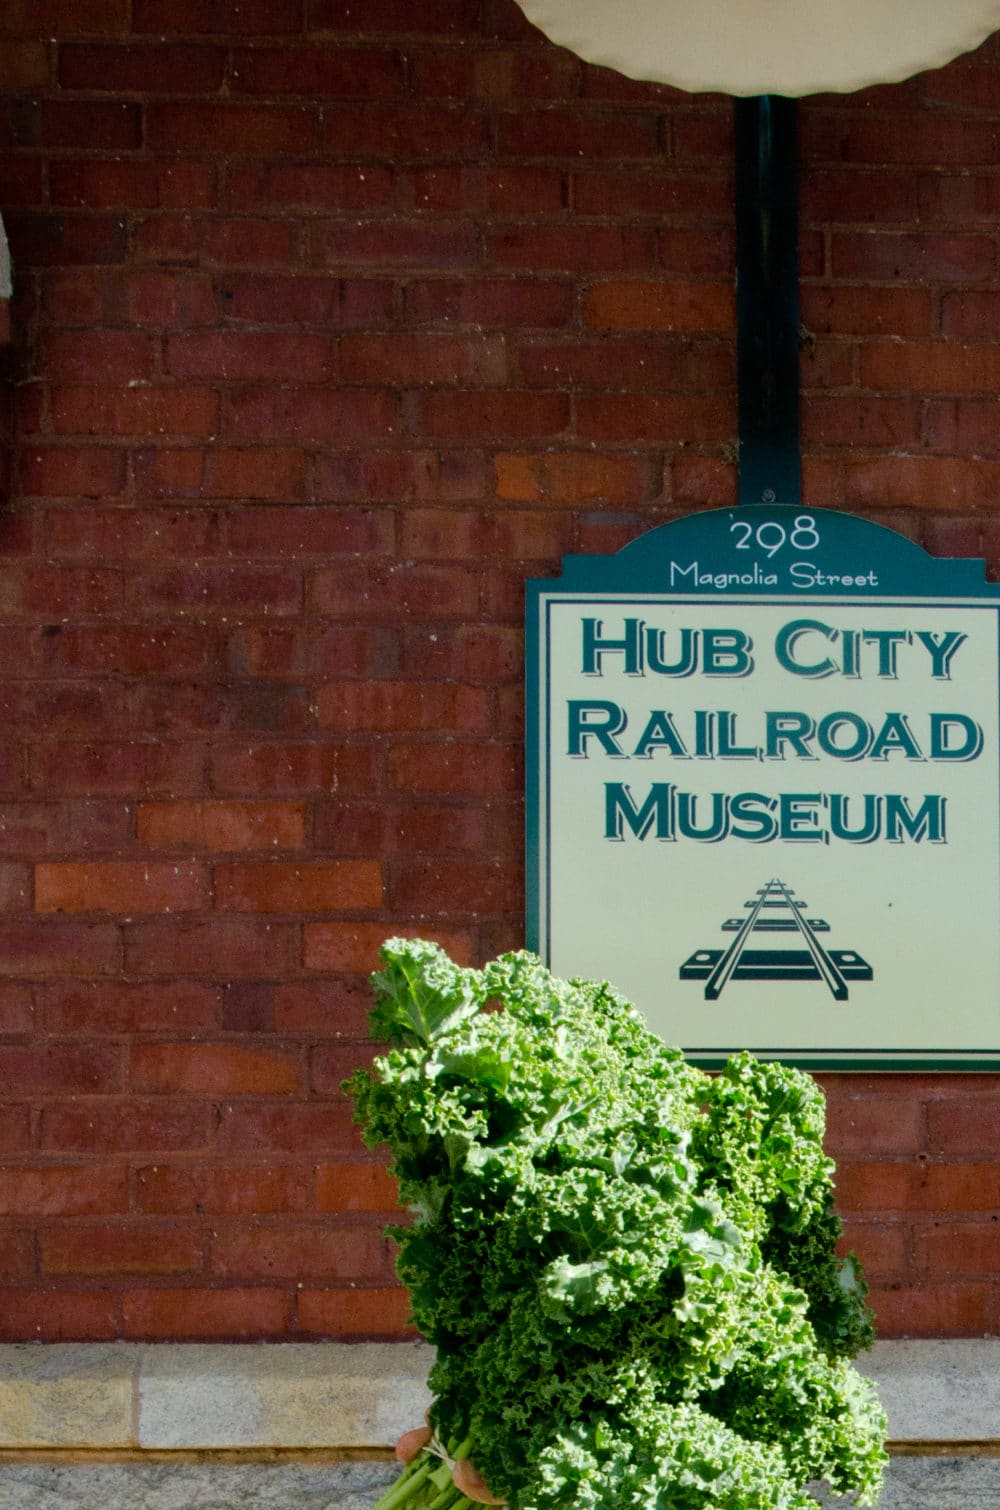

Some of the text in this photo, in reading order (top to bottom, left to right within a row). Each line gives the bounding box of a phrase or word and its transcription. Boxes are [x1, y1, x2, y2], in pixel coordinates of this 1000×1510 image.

[730, 515, 820, 559] 298
[670, 560, 879, 589] Magnolia Street
[579, 617, 969, 681] HUB CITY
[565, 699, 985, 763] RAILROAD
[603, 781, 949, 846] MUSEUM
